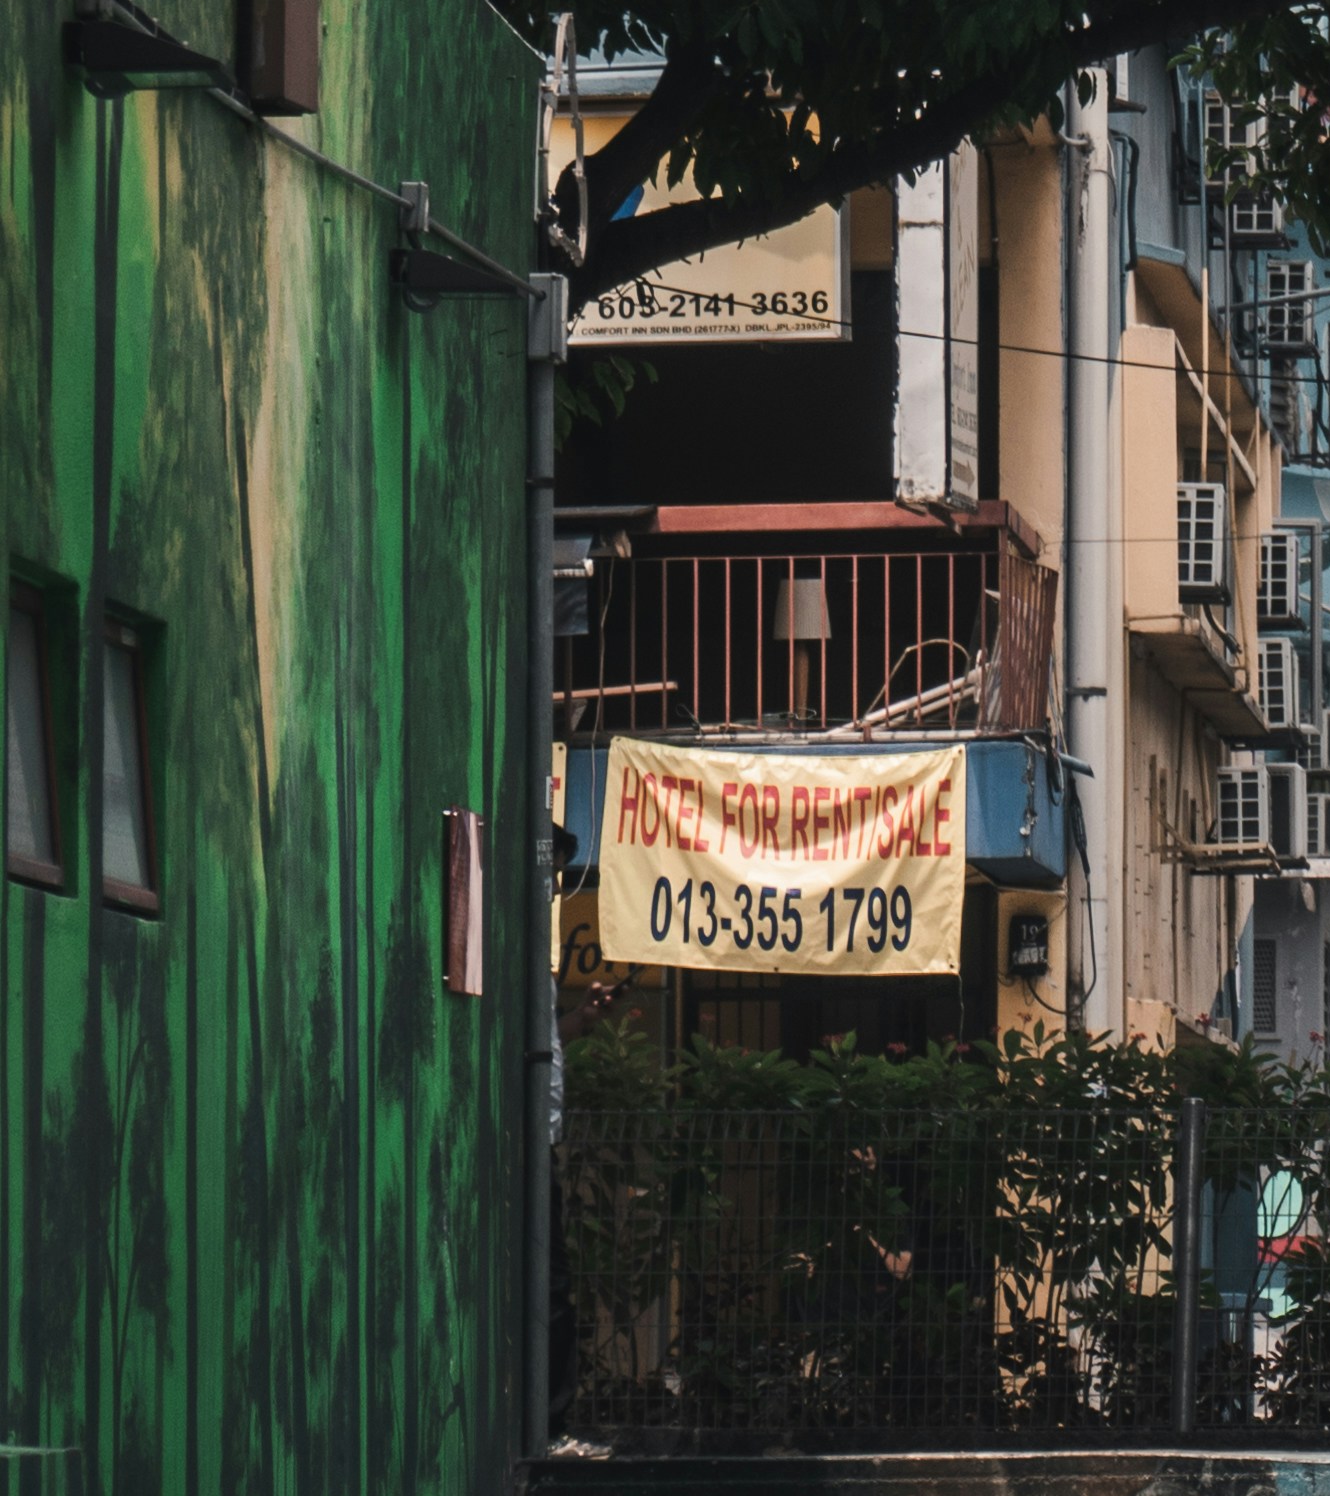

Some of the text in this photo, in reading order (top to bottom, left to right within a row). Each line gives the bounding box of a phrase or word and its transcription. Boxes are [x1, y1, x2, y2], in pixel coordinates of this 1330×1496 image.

[751, 290, 829, 315] 3636
[581, 326, 629, 336] COMFORT
[631, 326, 647, 335] INN
[650, 325, 670, 335] SDN
[672, 324, 691, 334] BHD
[617, 766, 952, 862] HOTEL FOR RENT/SALE
[649, 875, 912, 954] 013-355 1799
